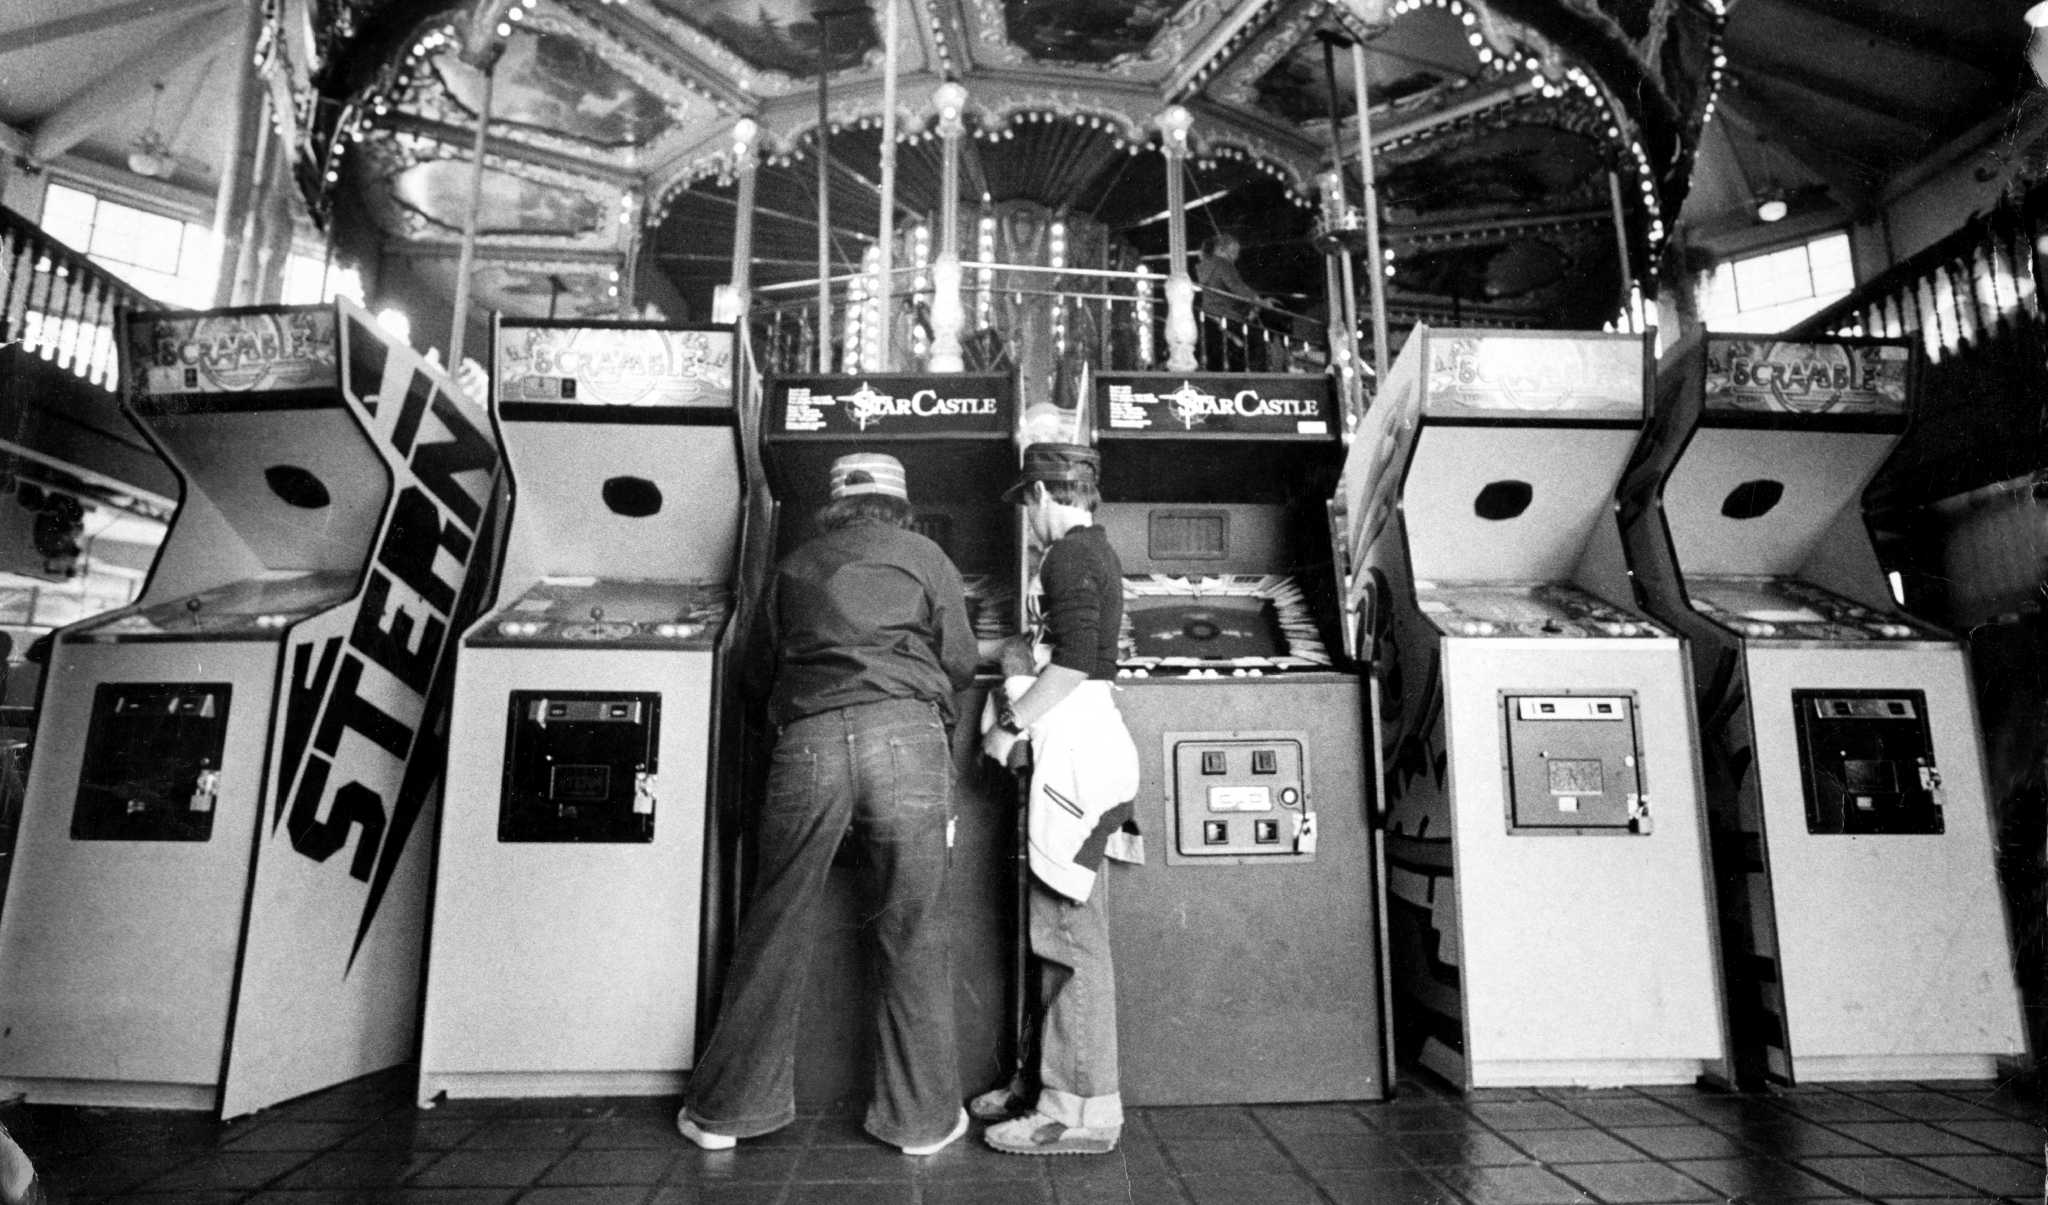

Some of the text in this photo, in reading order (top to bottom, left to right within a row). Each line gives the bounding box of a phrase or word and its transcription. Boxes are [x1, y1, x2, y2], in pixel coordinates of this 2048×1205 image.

[156, 331, 307, 370] SCRAMBLE
[1732, 357, 1876, 395] SCRAMBLE
[286, 388, 499, 884] STERN
